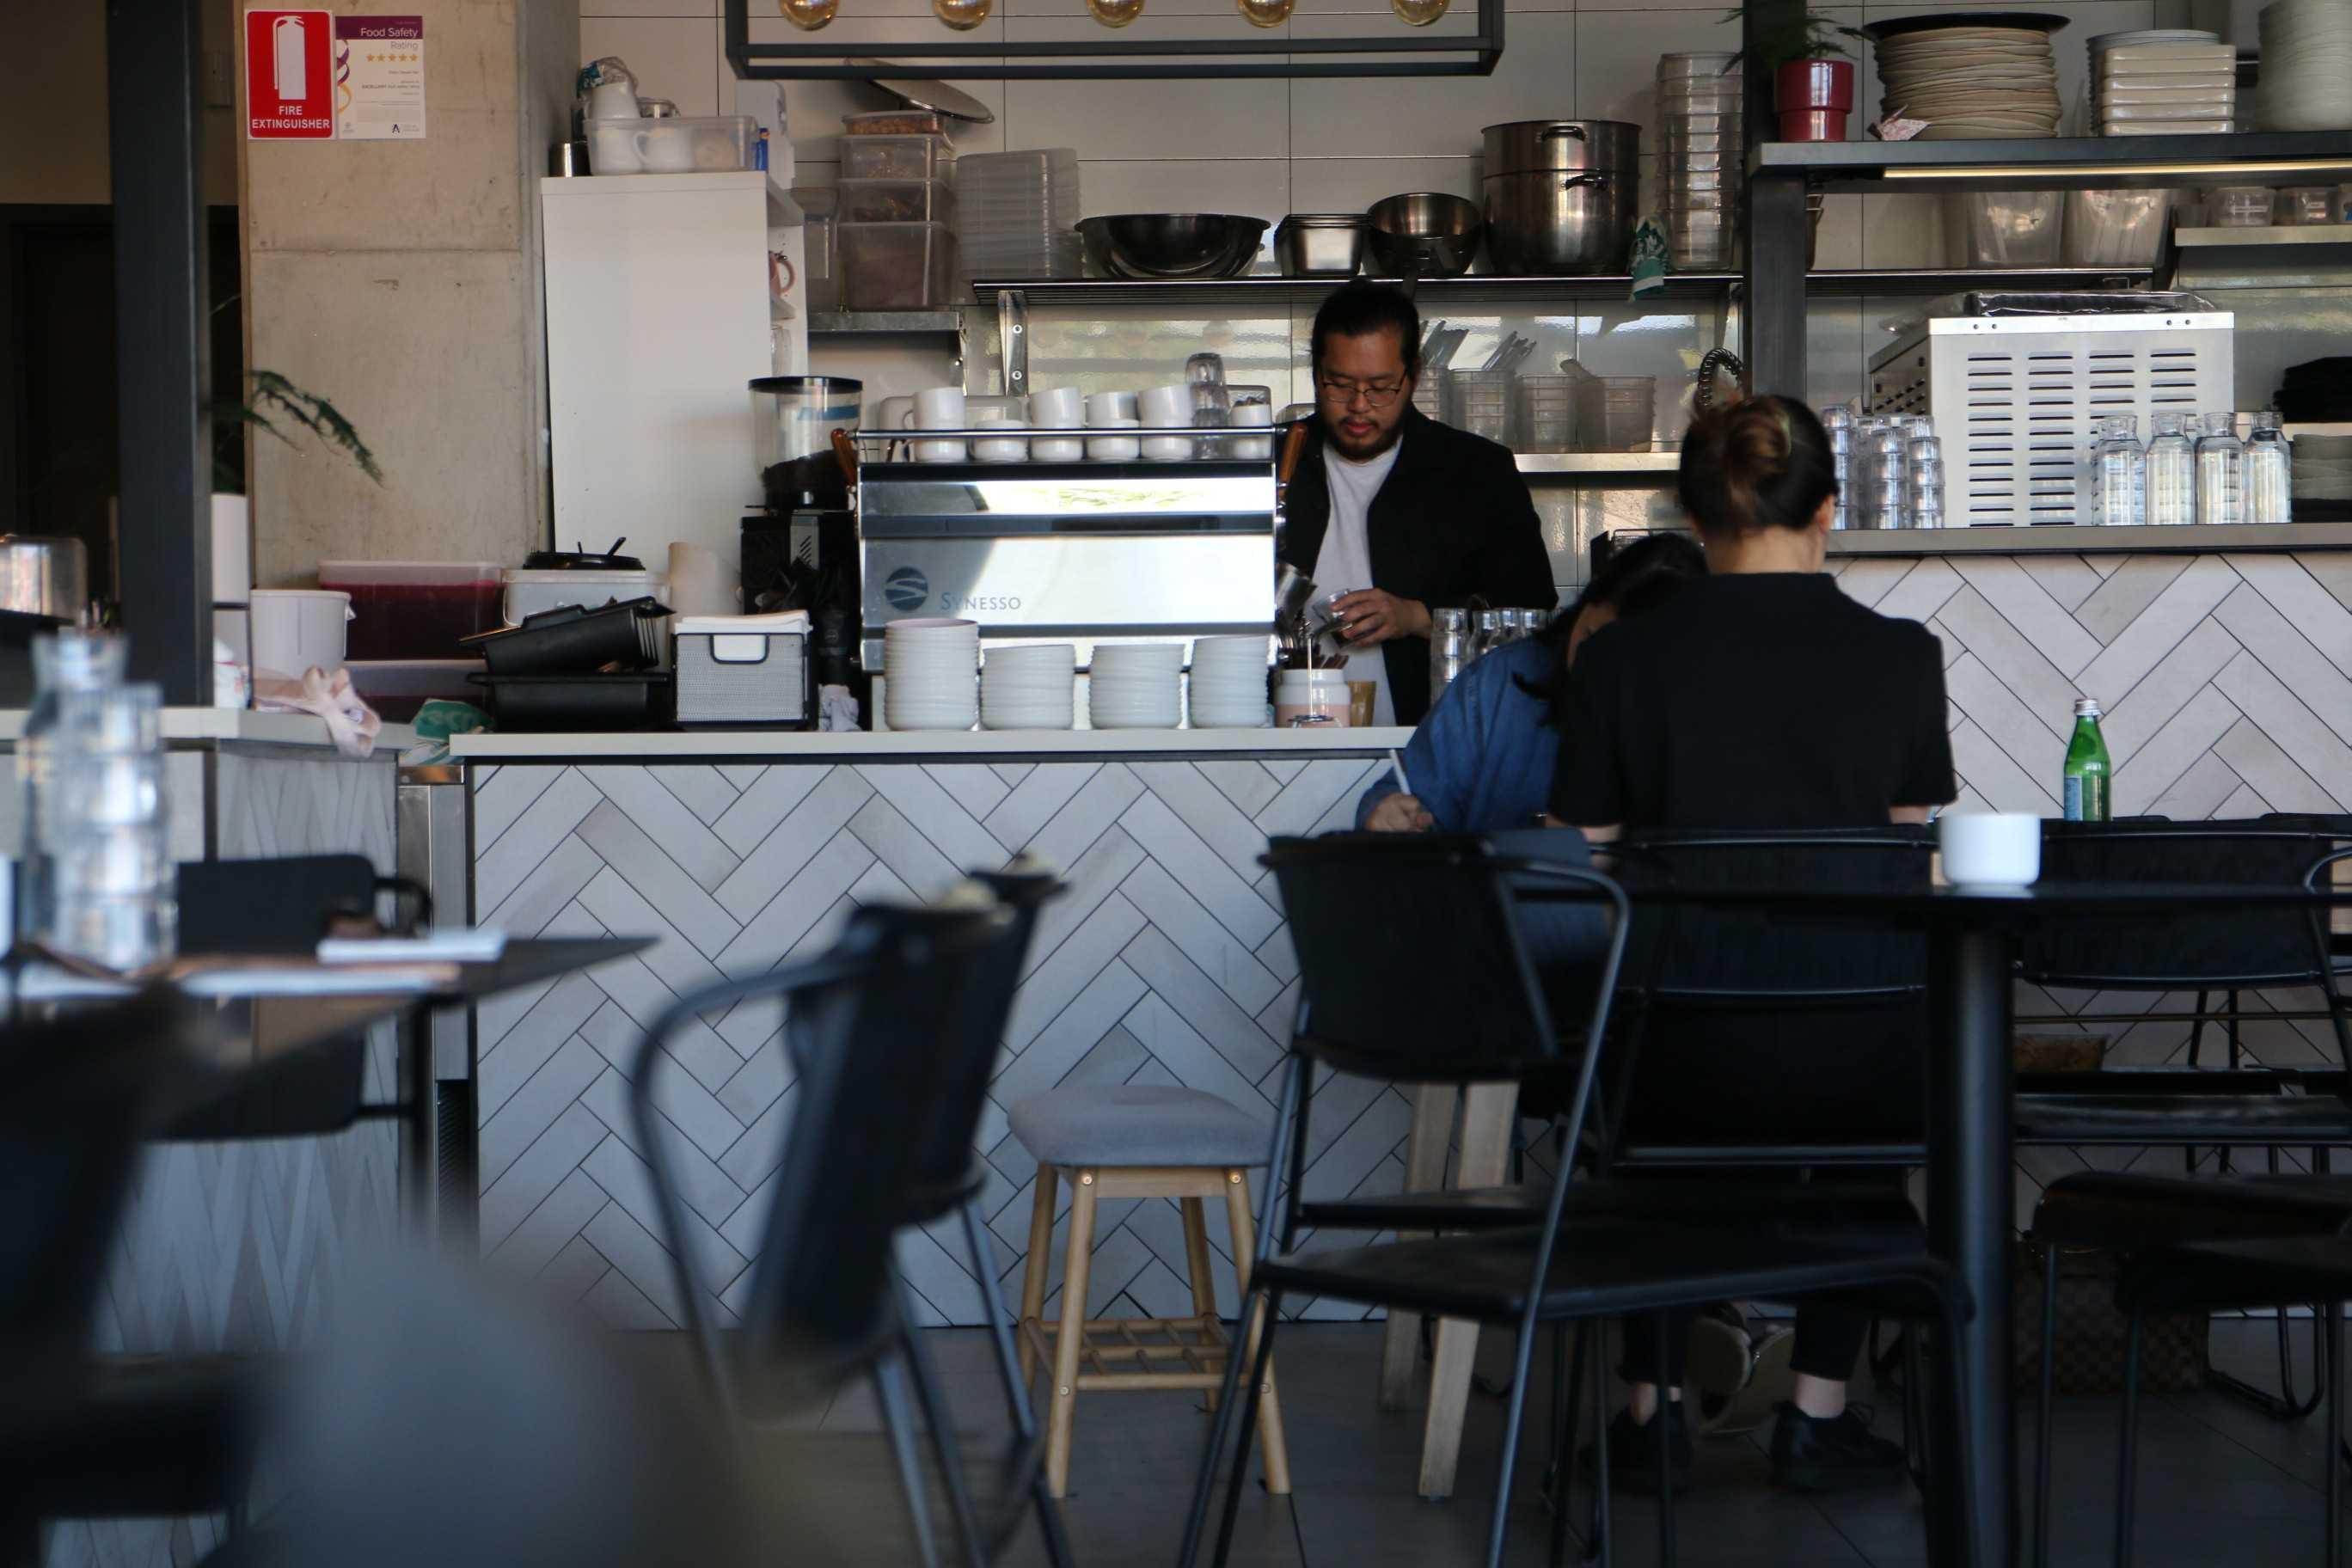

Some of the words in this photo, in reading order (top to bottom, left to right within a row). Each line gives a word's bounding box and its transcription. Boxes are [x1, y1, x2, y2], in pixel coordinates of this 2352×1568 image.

[360, 28, 385, 37] Food
[388, 28, 419, 39] Safety
[390, 41, 419, 52] Rating
[279, 106, 303, 115] FIRE
[252, 119, 330, 129] EXTINGUISHER
